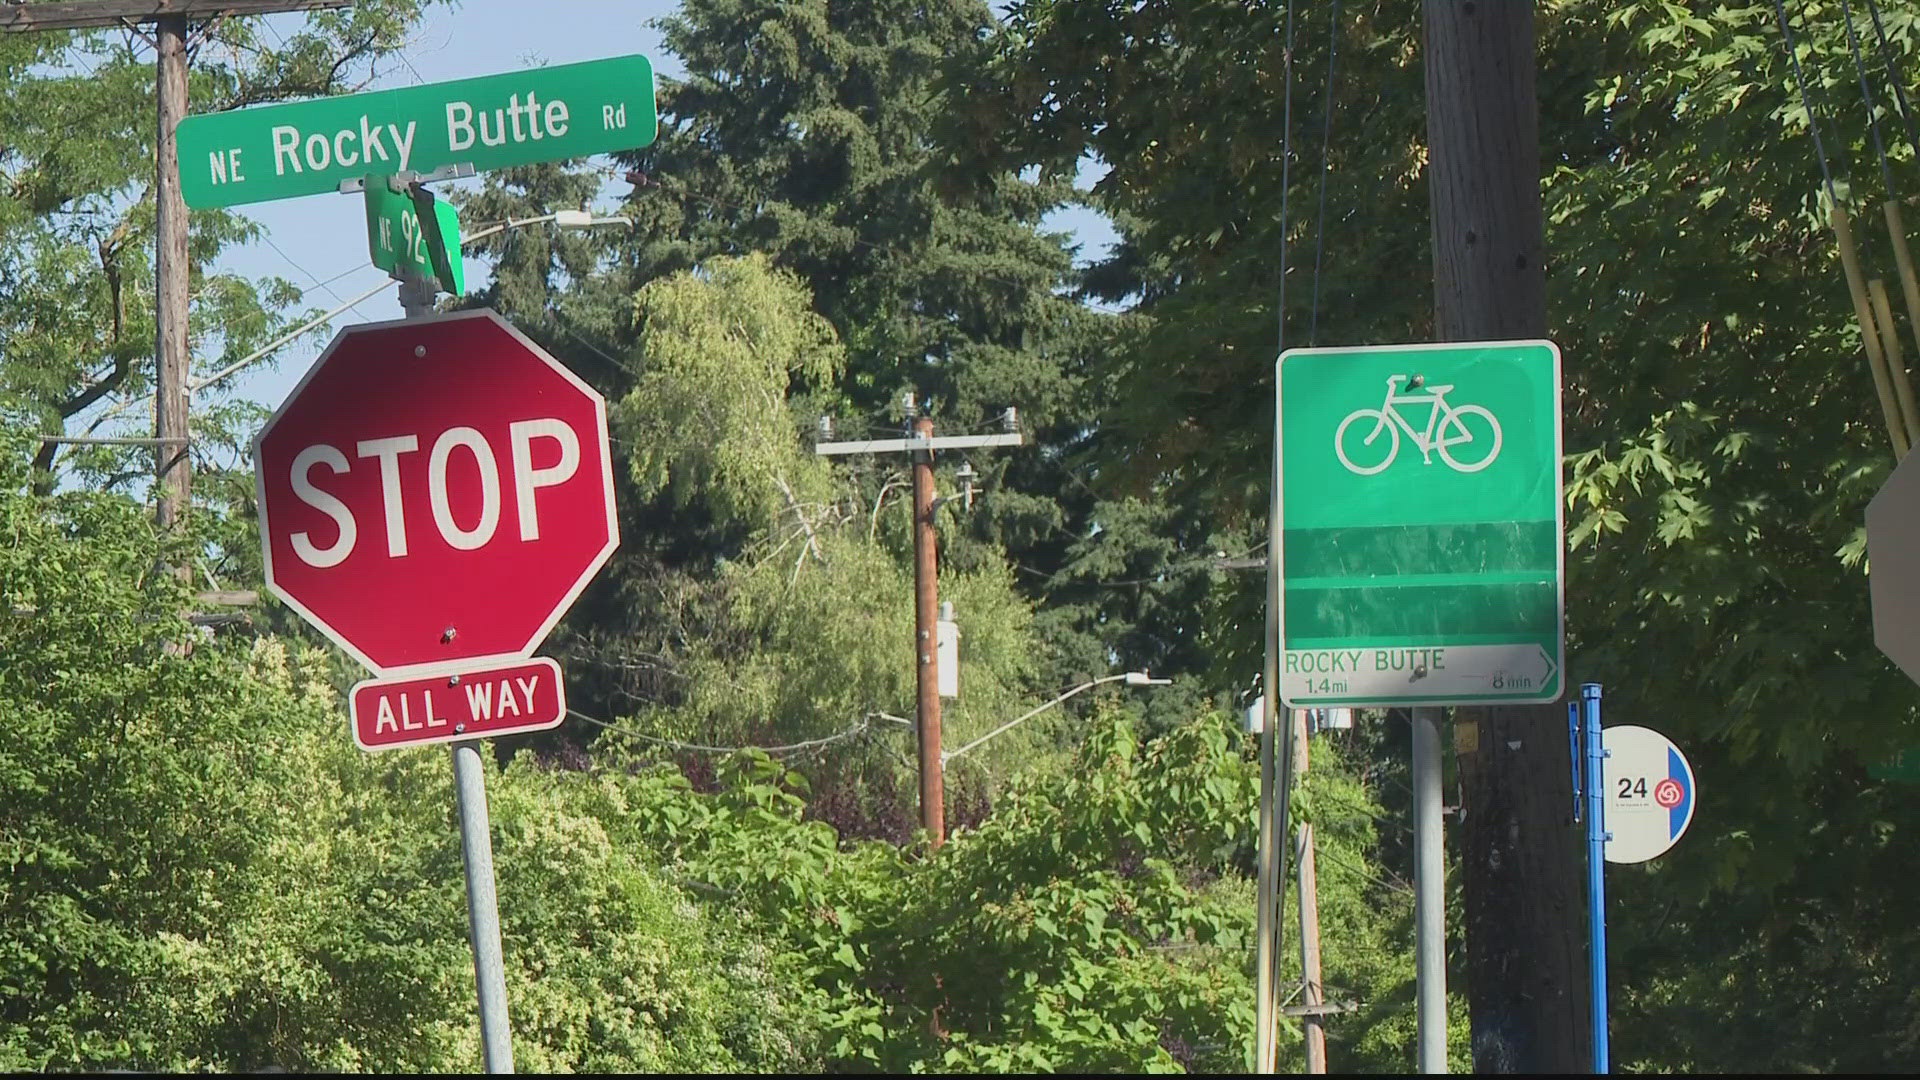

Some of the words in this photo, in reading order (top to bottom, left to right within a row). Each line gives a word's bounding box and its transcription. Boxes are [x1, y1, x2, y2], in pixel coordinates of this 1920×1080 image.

[209, 148, 245, 185] NE
[271, 114, 416, 175] Rocky
[446, 91, 569, 151] Butte
[602, 103, 626, 130] Rd
[379, 216, 393, 252] NE
[290, 417, 581, 568] STOP
[1285, 651, 1362, 673] ROCKY
[1375, 649, 1445, 671] BUTTE
[375, 690, 448, 734] ALL
[465, 676, 539, 722] WAY
[1618, 777, 1648, 799] 24
